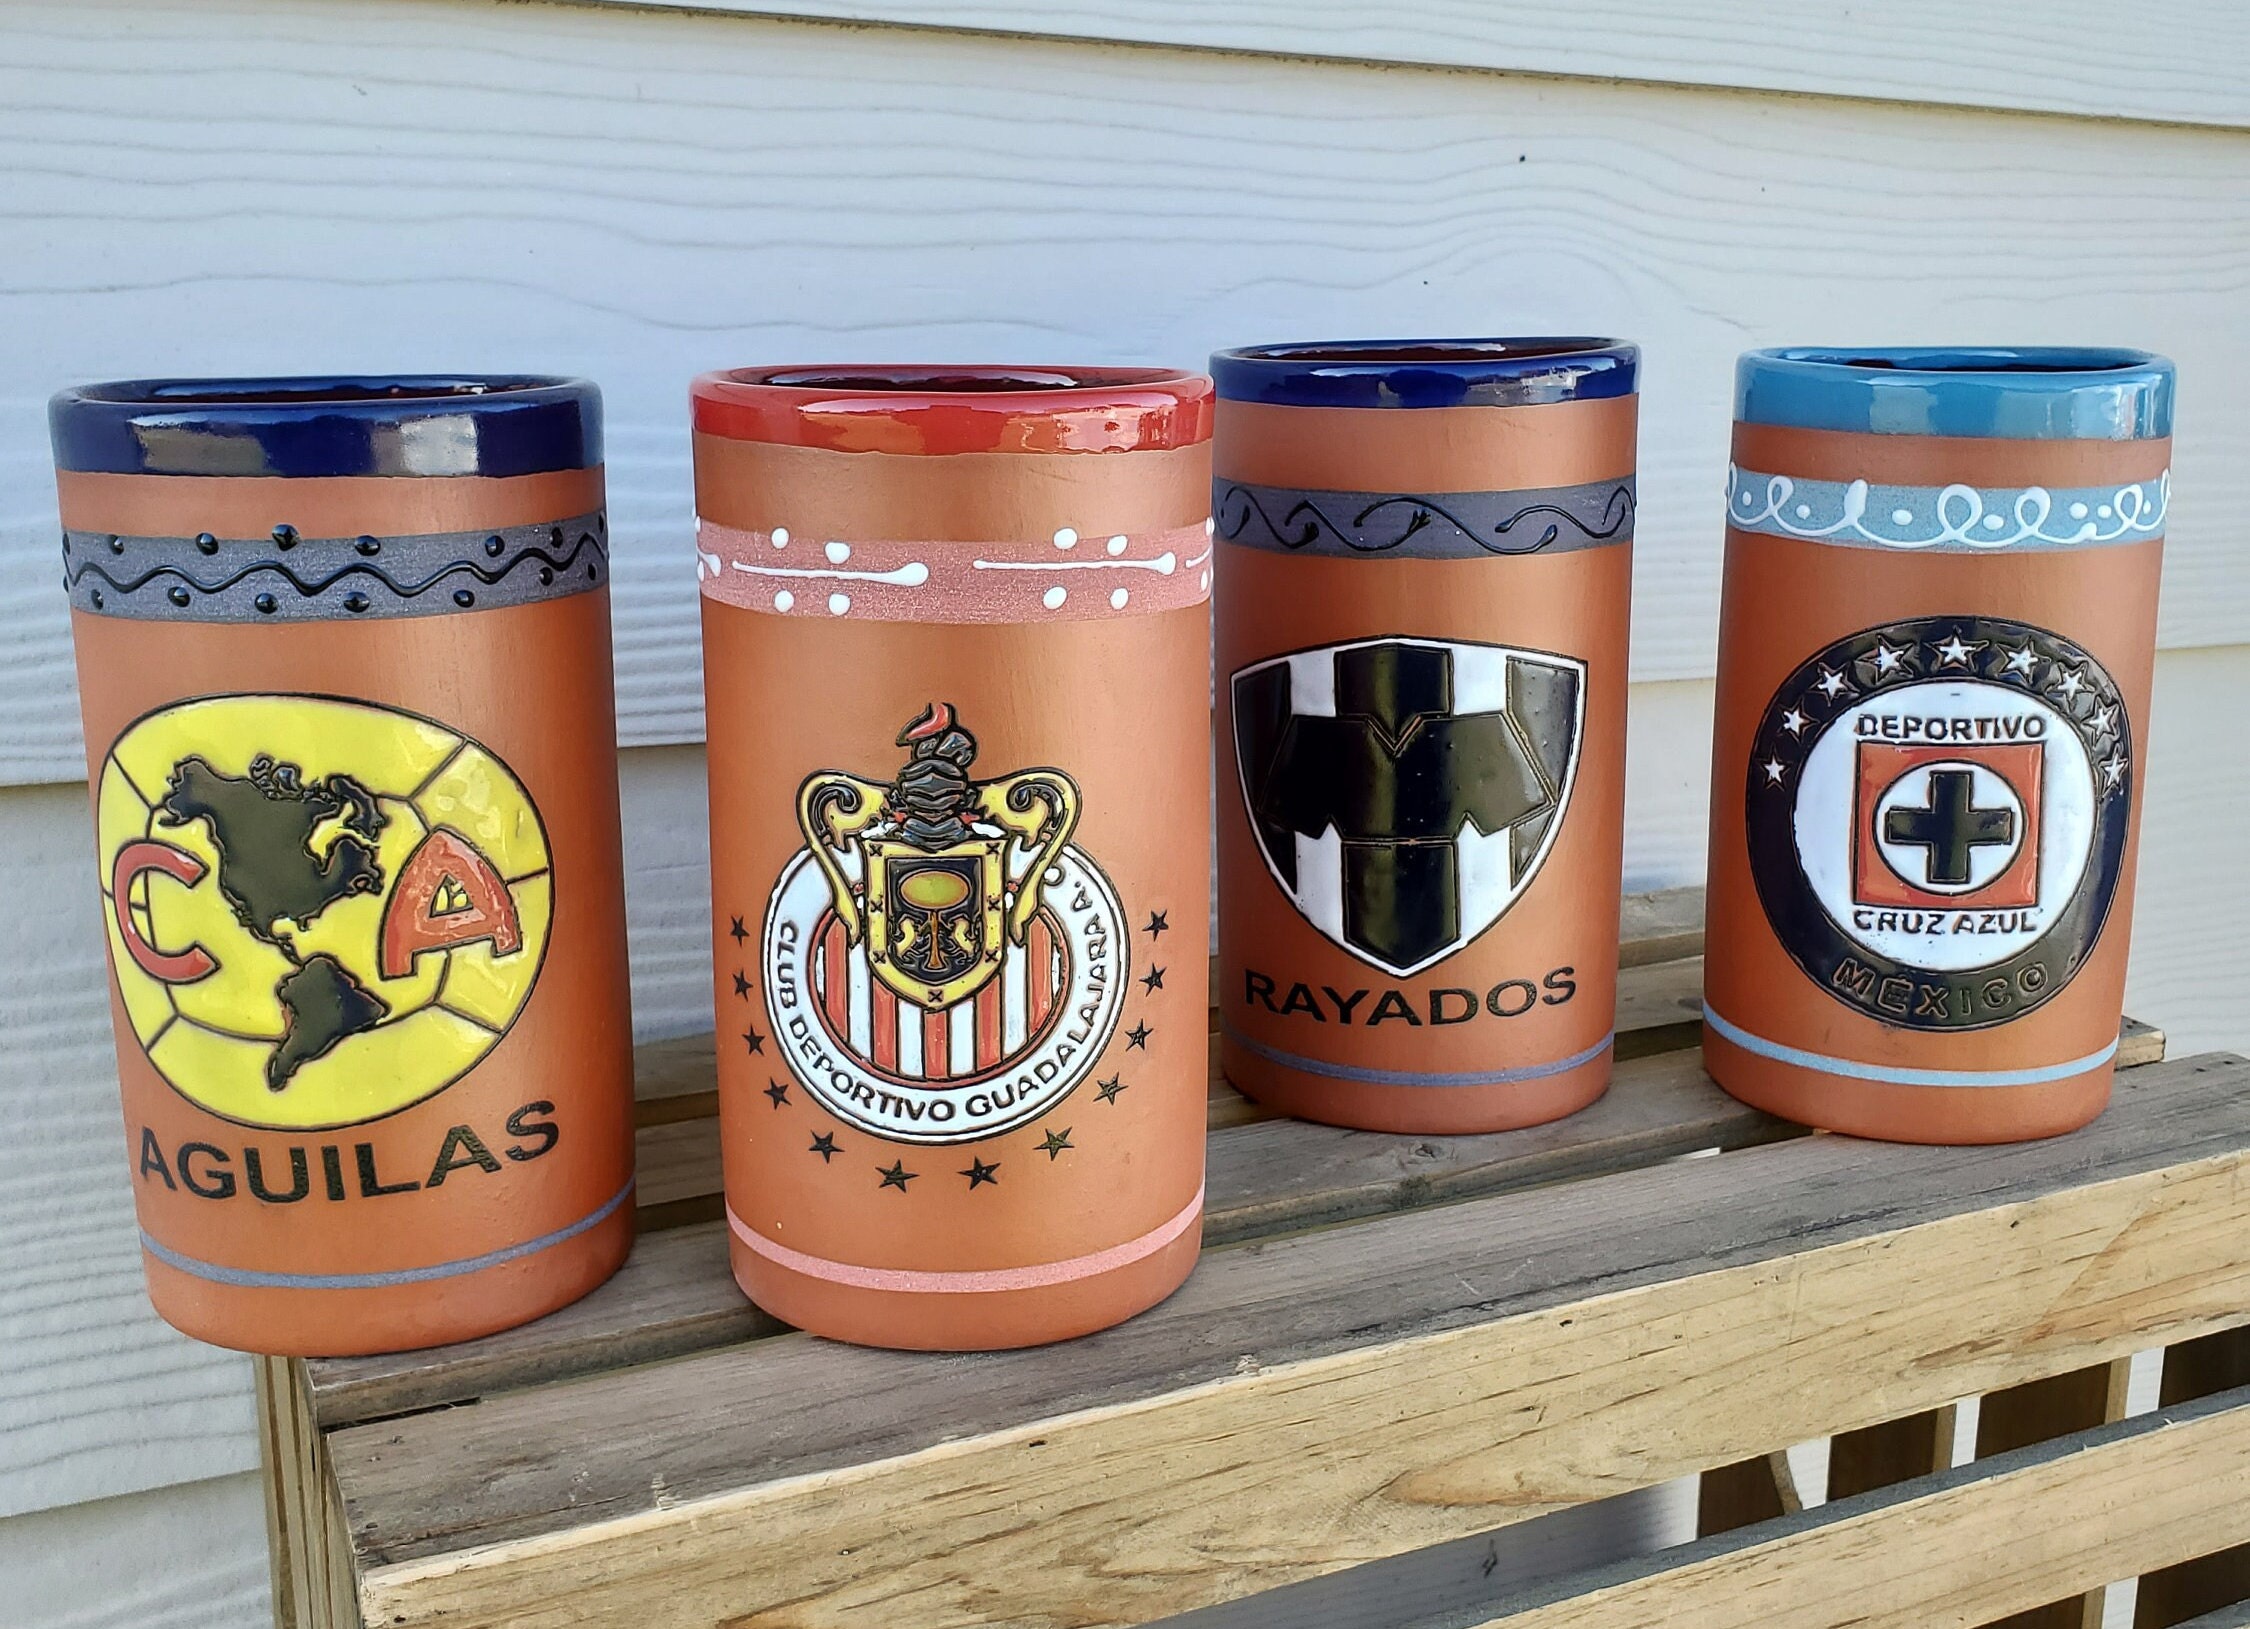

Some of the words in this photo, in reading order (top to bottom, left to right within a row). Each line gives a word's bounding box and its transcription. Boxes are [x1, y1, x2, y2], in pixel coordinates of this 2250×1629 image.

[1855, 714, 2047, 740] DEPORTIVO
[113, 838, 221, 984] C
[380, 826, 523, 981] A
[1853, 910, 1946, 935] CRUZ
[1951, 911, 2037, 934] AZUL
[778, 919, 799, 1009] CLUB
[789, 1013, 956, 1122] DEPORTIVO
[964, 912, 1108, 1116] GUADALAJARA
[1244, 966, 1577, 1026] RAYADOS
[139, 1100, 560, 1203] AGUILAS
